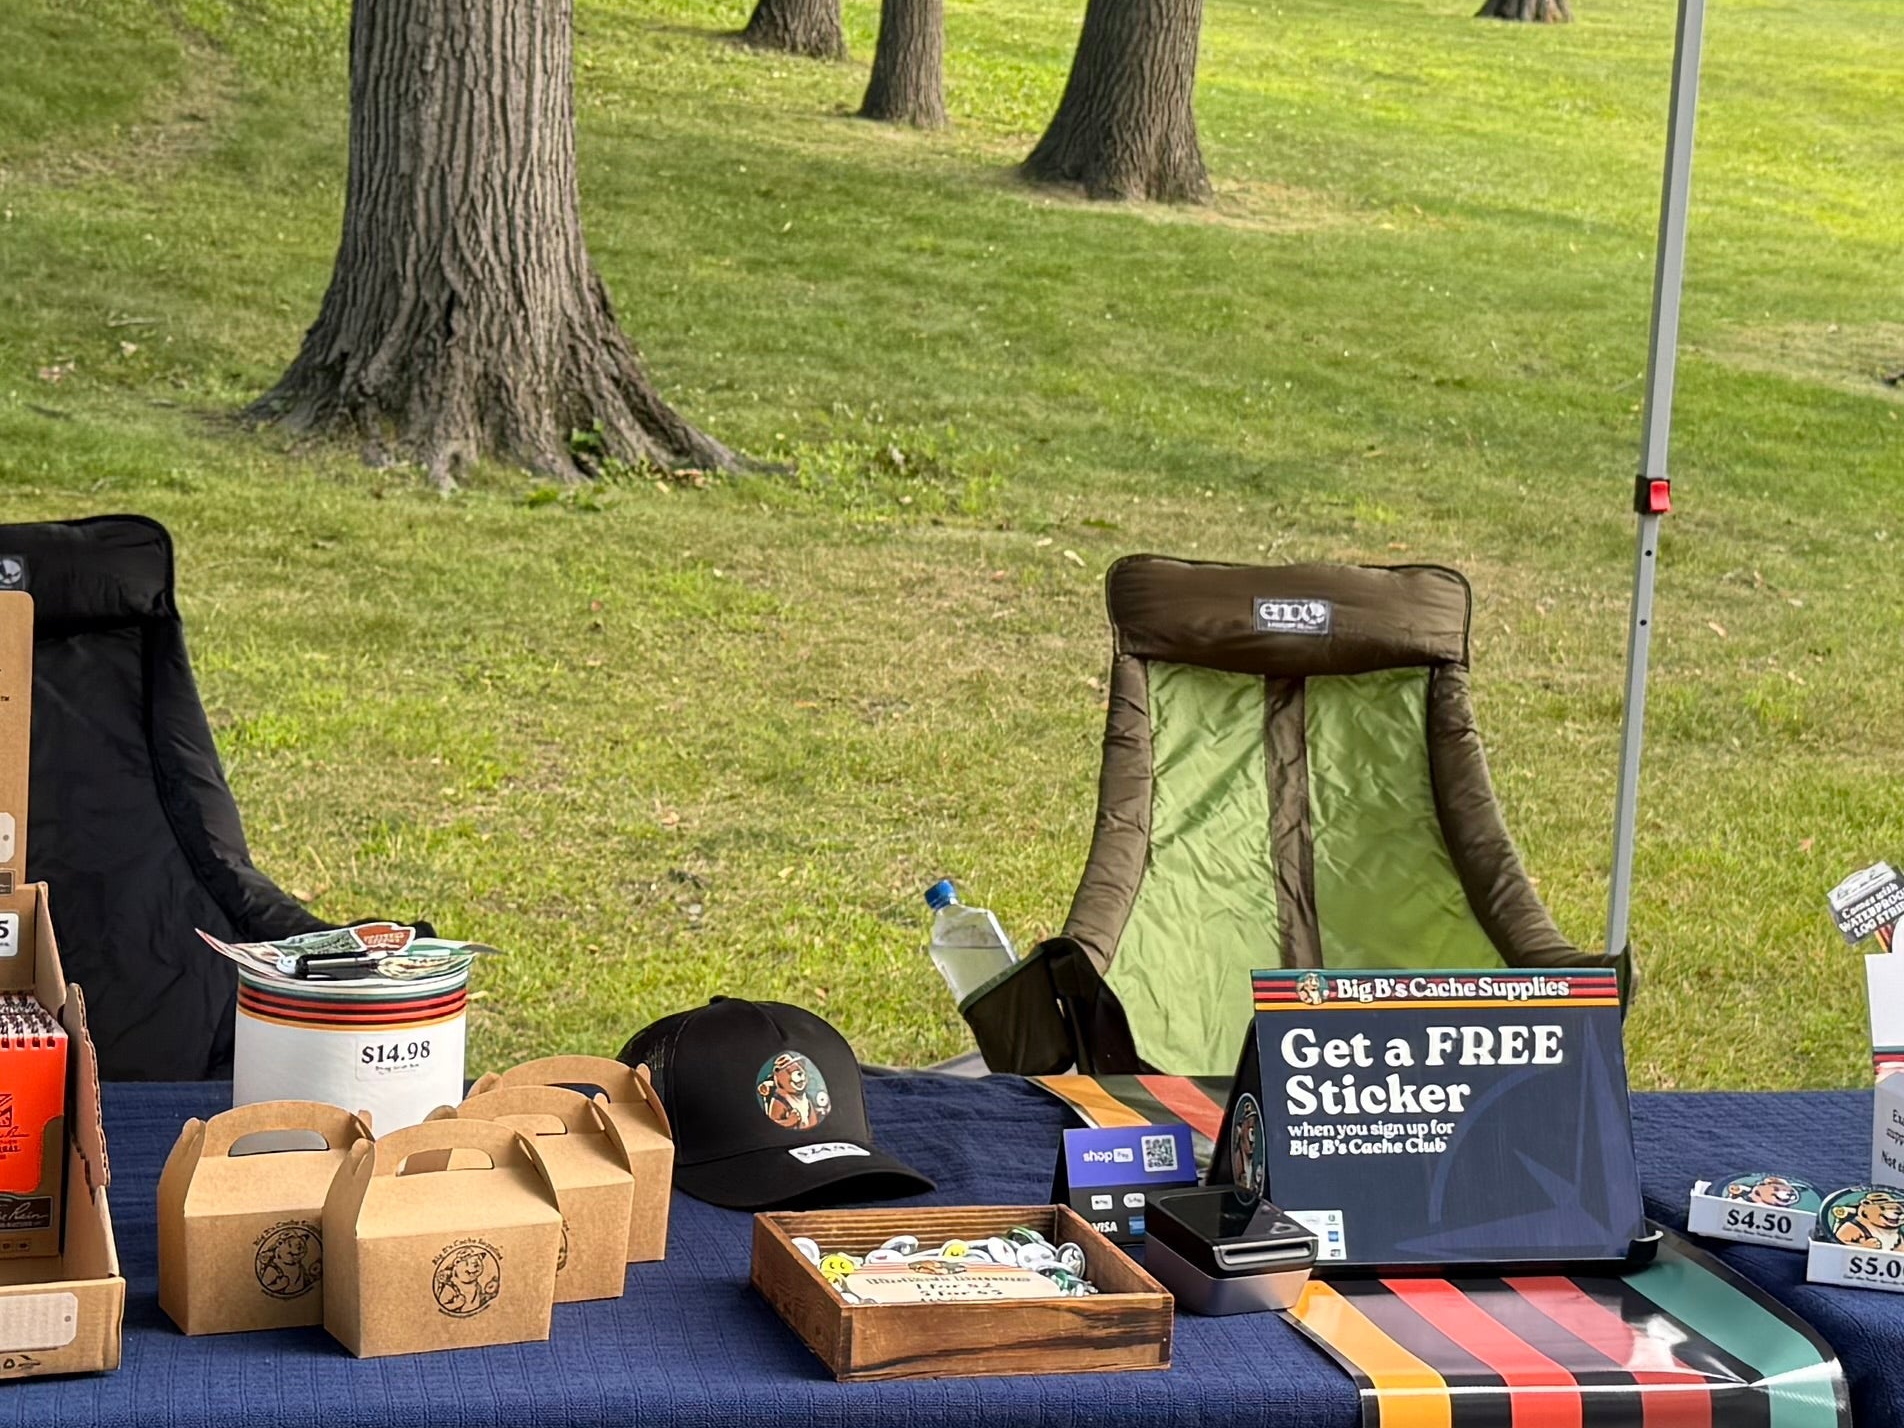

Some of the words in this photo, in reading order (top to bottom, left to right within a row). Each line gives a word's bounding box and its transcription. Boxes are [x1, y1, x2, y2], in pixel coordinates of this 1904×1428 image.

[1874, 882, 1899, 900] with
[1336, 979, 1373, 1002] Big
[1374, 978, 1408, 999] B's
[1410, 977, 1477, 998] Cache
[1479, 976, 1570, 1001] Supplies
[361, 1040, 431, 1065] $14.98
[1280, 1028, 1374, 1069] Get
[1384, 1038, 1414, 1067] a
[1425, 1025, 1564, 1066] FREE
[1285, 1073, 1471, 1116] Sticker
[1287, 1122, 1333, 1137] when
[1336, 1125, 1370, 1140] you
[1371, 1120, 1405, 1139] sign
[1406, 1123, 1429, 1139] up
[1430, 1119, 1454, 1135] for
[1083, 1150, 1113, 1163] shop
[1290, 1139, 1320, 1159] Big
[1321, 1139, 1347, 1155] B's
[1348, 1138, 1403, 1155] Cache
[1405, 1138, 1446, 1154] Club
[1881, 1149, 1897, 1169] Not
[1092, 1221, 1118, 1232] VISA
[1726, 1209, 1792, 1235] $4.50
